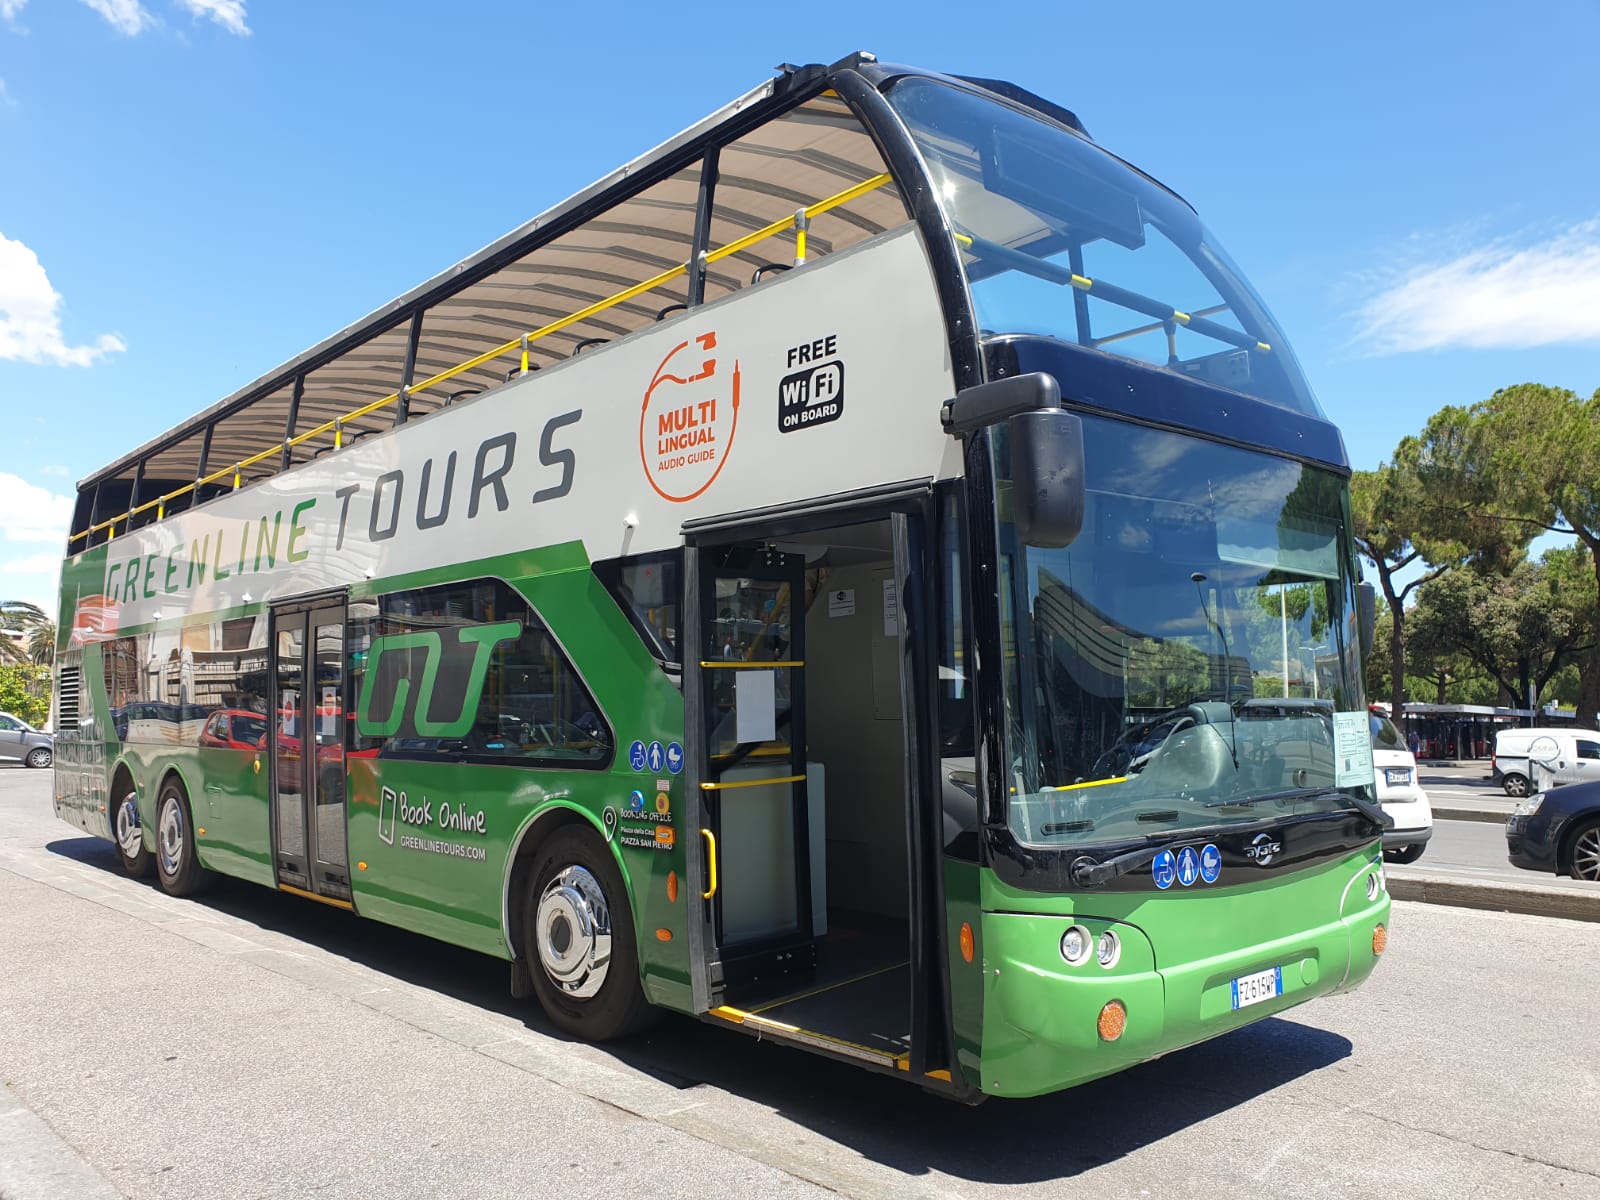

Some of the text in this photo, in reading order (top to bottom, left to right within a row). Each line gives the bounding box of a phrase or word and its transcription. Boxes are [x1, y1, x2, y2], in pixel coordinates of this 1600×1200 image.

[787, 334, 837, 368] FREE
[782, 372, 834, 407] WiFi
[658, 399, 716, 436] MULTI
[783, 403, 838, 427] ON BOARD
[658, 427, 716, 455] LINGUAL
[657, 448, 715, 472] AUDIO GUIDE
[106, 408, 583, 604] GREENLINE TOURS
[400, 791, 486, 834] Book Online
[400, 835, 486, 861] GREENLINETOURS.COM
[620, 837, 639, 846] PIAZZA
[640, 839, 651, 848] SAN
